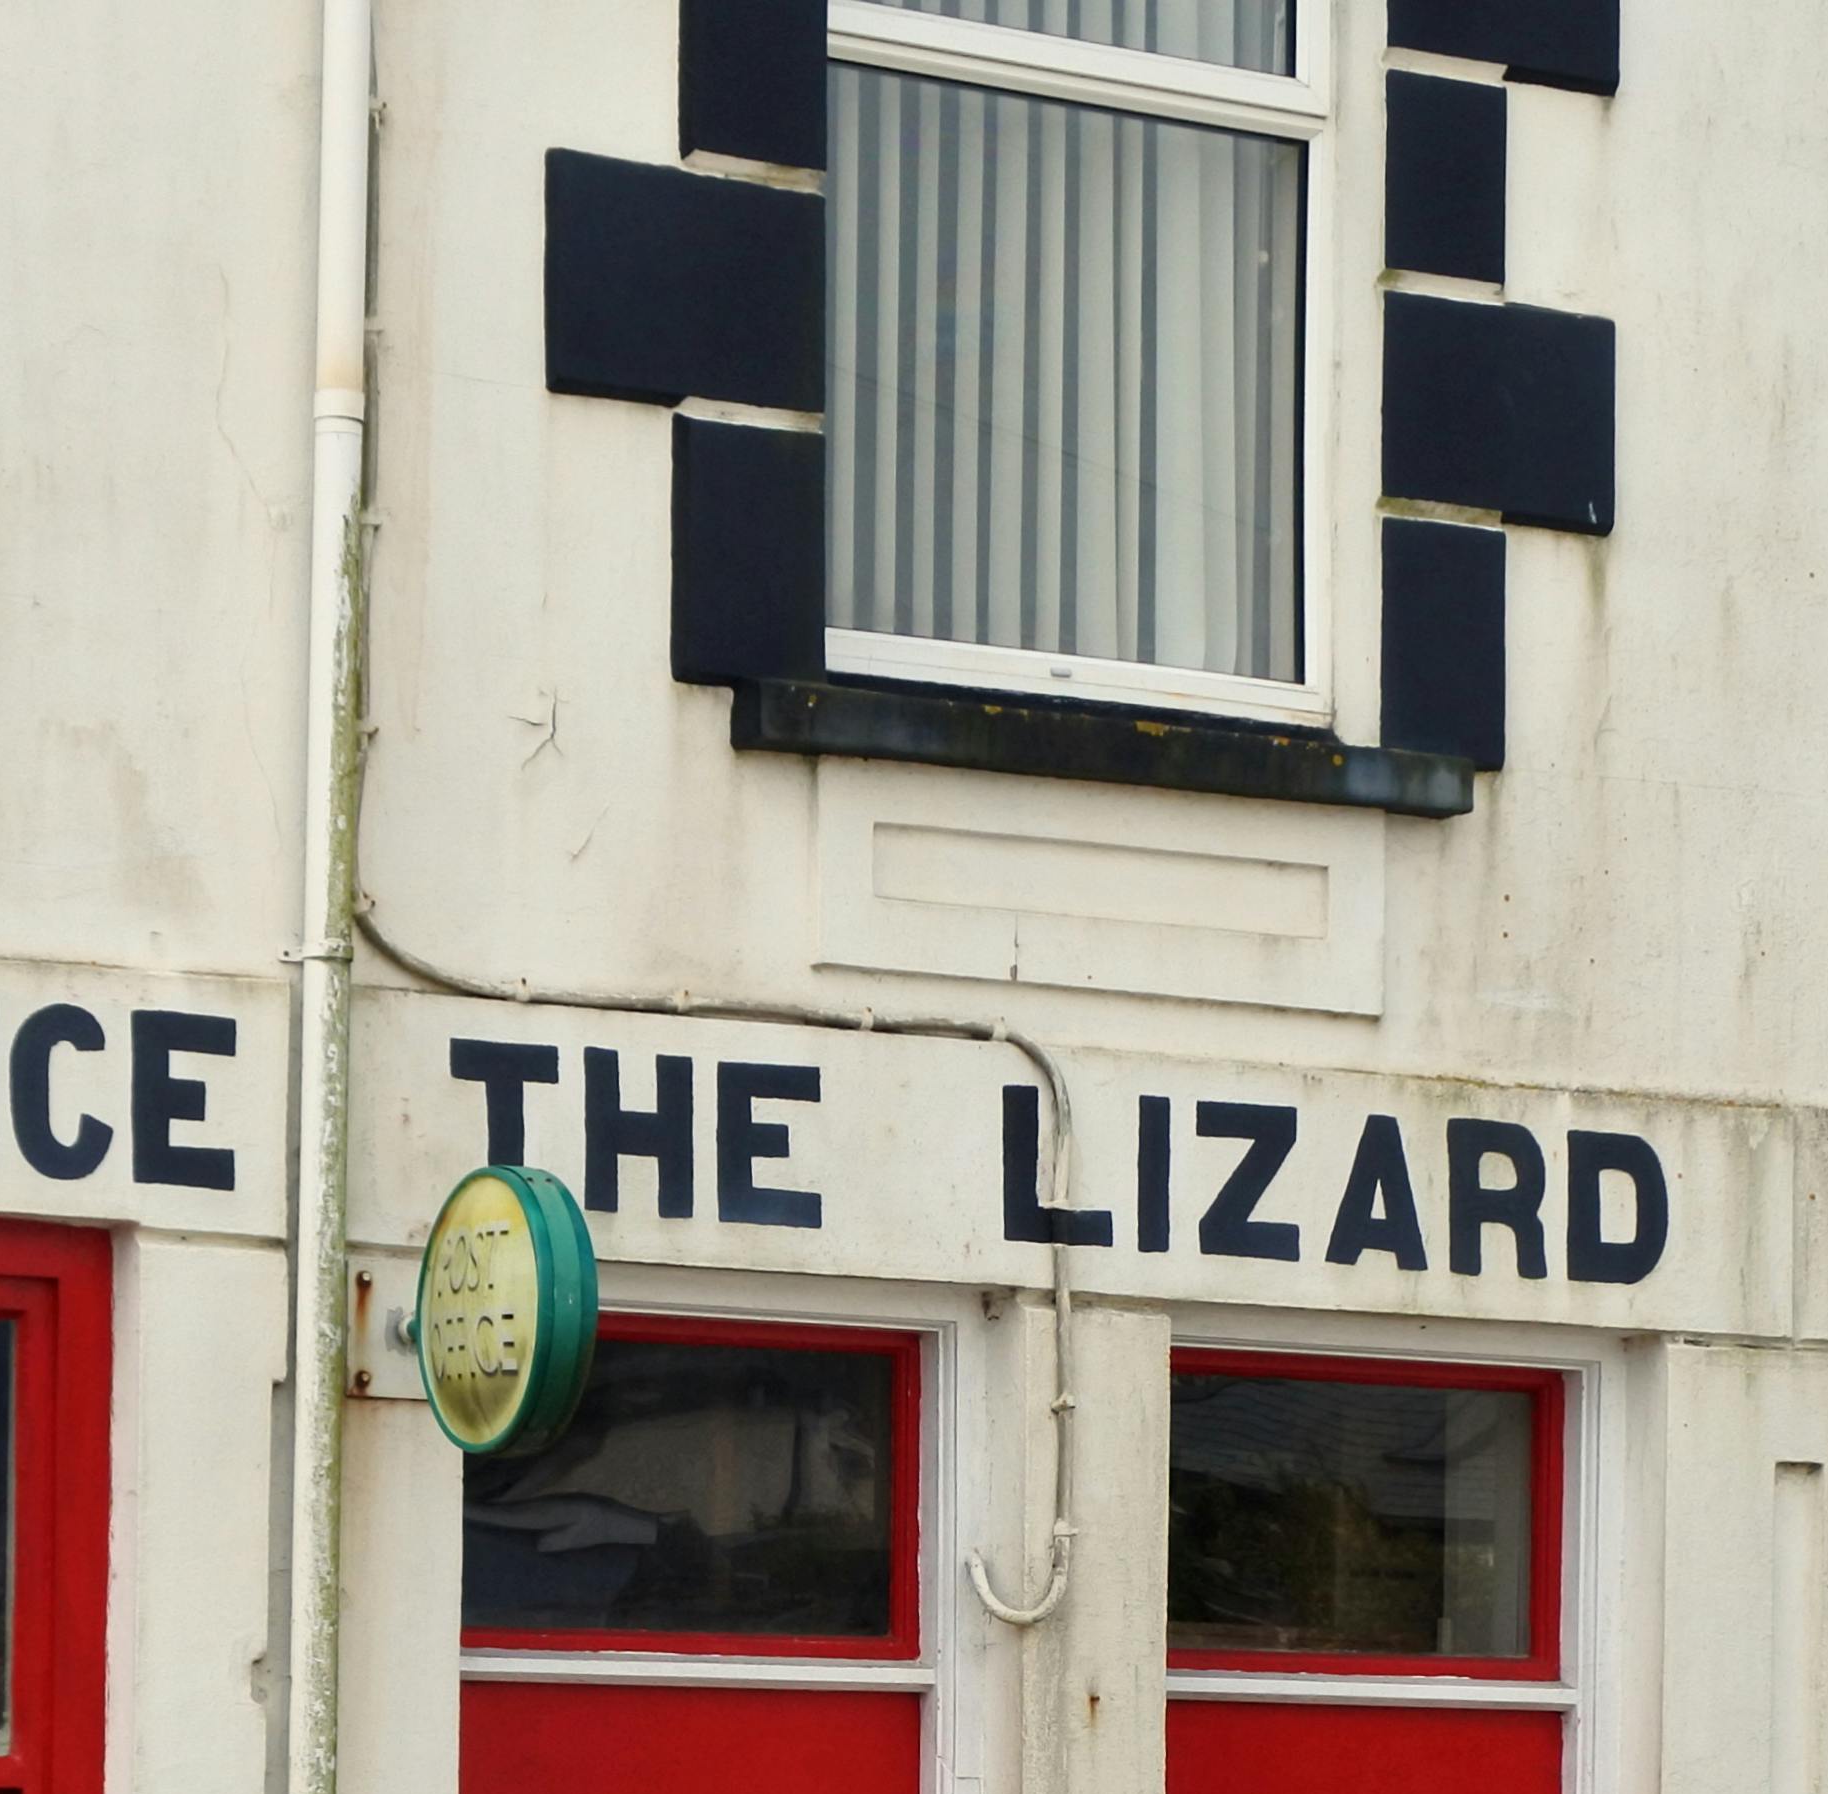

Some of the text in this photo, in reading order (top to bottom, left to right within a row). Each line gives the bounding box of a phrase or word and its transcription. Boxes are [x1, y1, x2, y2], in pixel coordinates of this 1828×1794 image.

[450, 1038, 1668, 1285] THE LIZARD
[436, 1220, 510, 1298] POST
[432, 1312, 518, 1383] OFFICE
